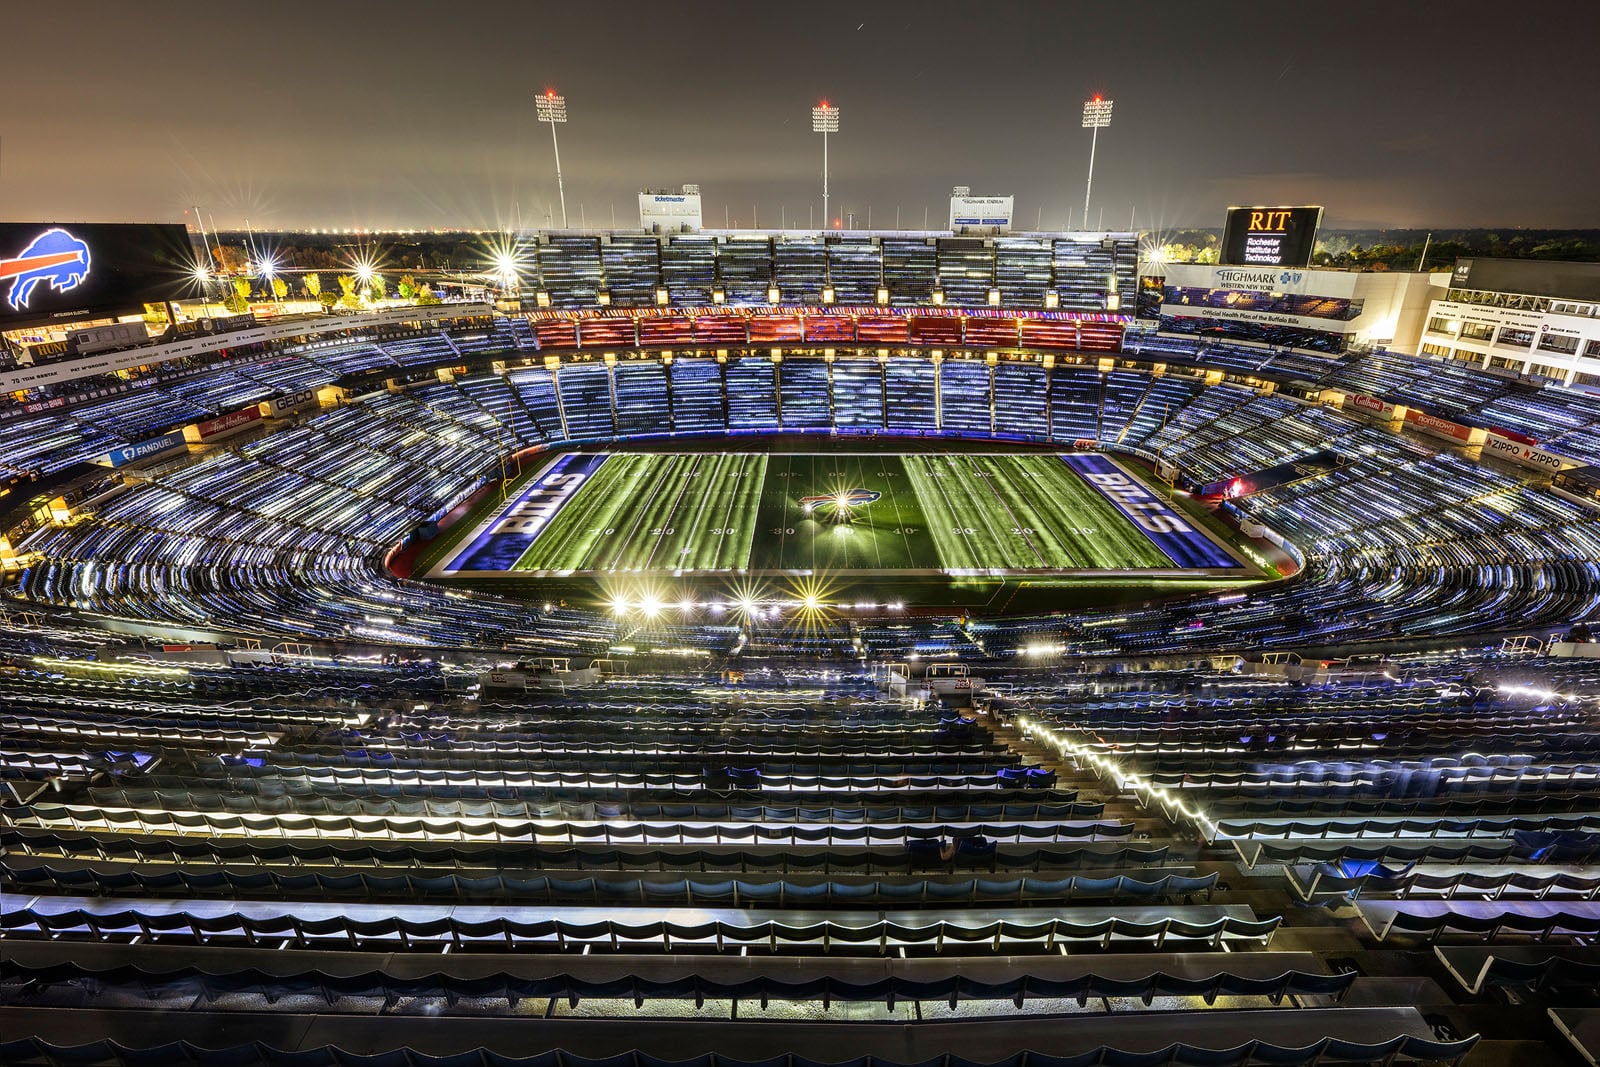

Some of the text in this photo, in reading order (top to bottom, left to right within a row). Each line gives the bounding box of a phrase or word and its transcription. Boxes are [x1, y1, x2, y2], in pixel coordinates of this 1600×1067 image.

[1248, 211, 1291, 230] RIT
[1245, 246, 1271, 254] Institute
[1247, 238, 1280, 246] Rochester
[1245, 254, 1281, 263] Technology
[1218, 270, 1276, 284] HIGHMARK
[1202, 309, 1221, 317] Official
[1268, 315, 1287, 323] Buffalo
[38, 341, 68, 356] HUNT
[276, 390, 313, 410] GEICO
[1356, 395, 1381, 410] Galbani
[211, 415, 250, 433] Tim Hortons
[1418, 415, 1456, 432] northtown
[136, 438, 175, 455] FANDUEL
[1492, 439, 1520, 455] ZIPPO
[1530, 451, 1560, 467] ZIPPO
[489, 473, 586, 535] BILLS
[1084, 473, 1192, 533] BILLS
